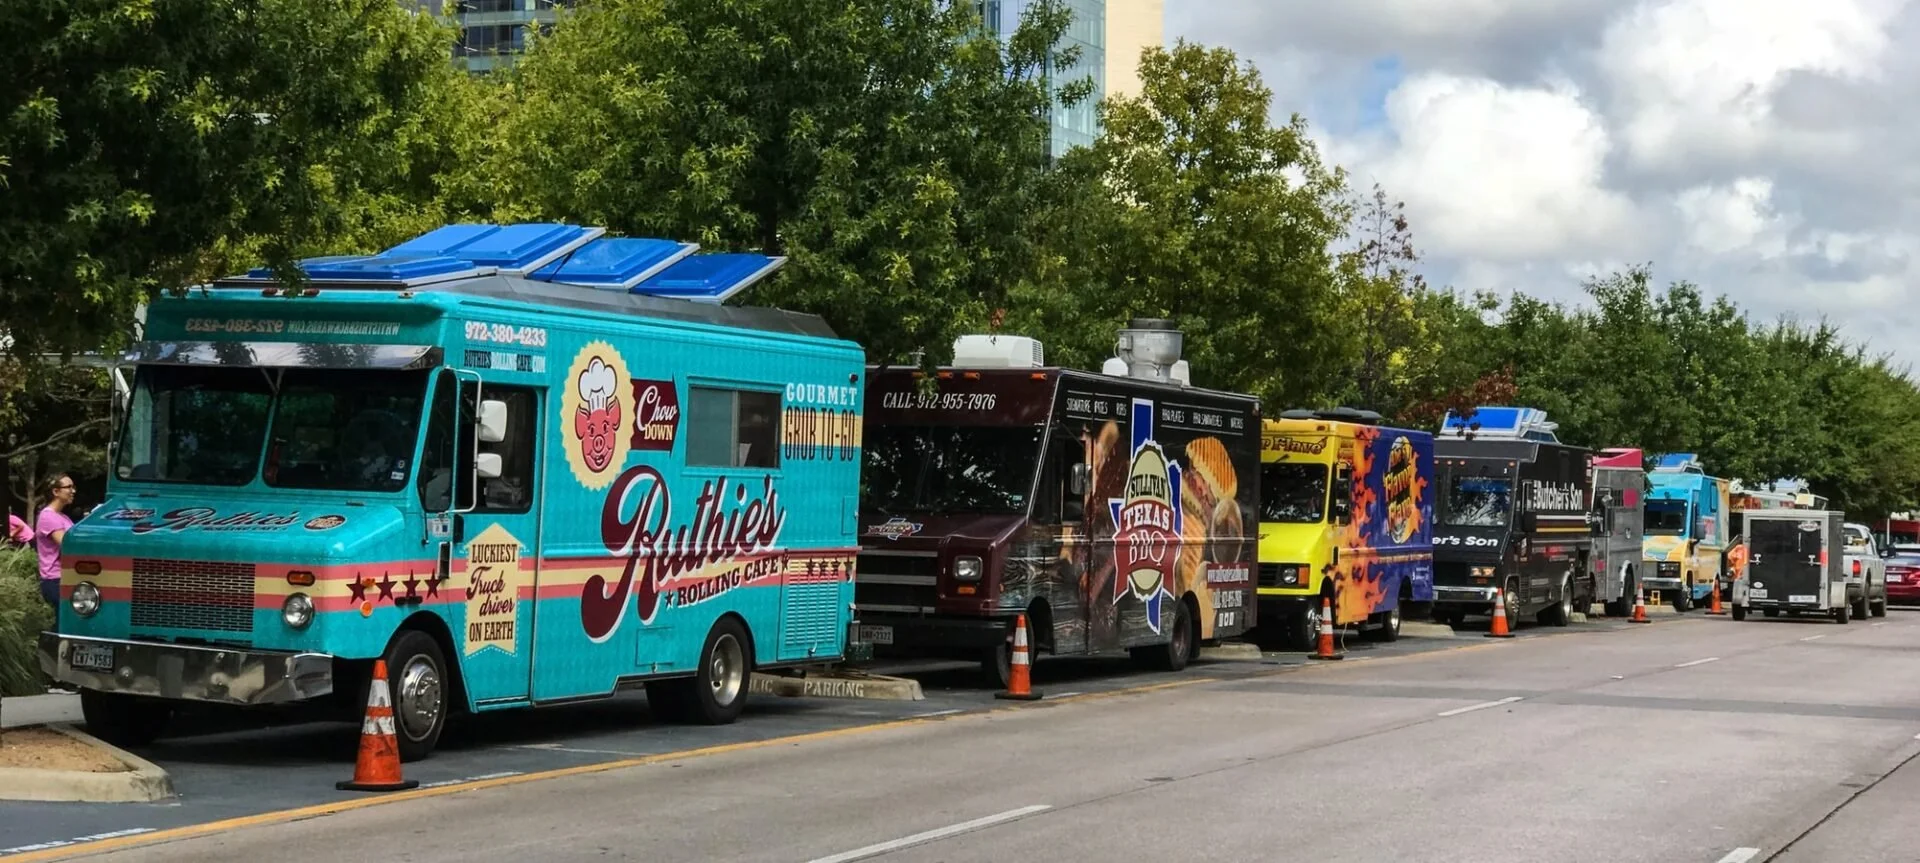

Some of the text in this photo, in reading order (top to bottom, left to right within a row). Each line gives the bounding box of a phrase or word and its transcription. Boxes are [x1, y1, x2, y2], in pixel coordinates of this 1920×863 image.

[464, 320, 547, 348] 972-380-4233
[786, 382, 858, 406] GOURMET
[882, 391, 915, 409] CALL:
[636, 385, 678, 433] Chow
[644, 423, 673, 441] DOWN
[785, 405, 856, 462] GRUB TO-GO
[1570, 481, 1583, 511] Son
[1124, 502, 1170, 532] TEXAS
[471, 543, 517, 564] LUCKIEST
[581, 465, 786, 644] Ruthie's
[1128, 530, 1168, 567] BBQ
[1464, 535, 1499, 547] Son
[466, 566, 505, 601] Truck
[677, 554, 780, 608] ROLLING CAFE
[479, 593, 514, 617] driver
[469, 620, 514, 643] ON EARTH
[803, 680, 865, 698] PARKING
